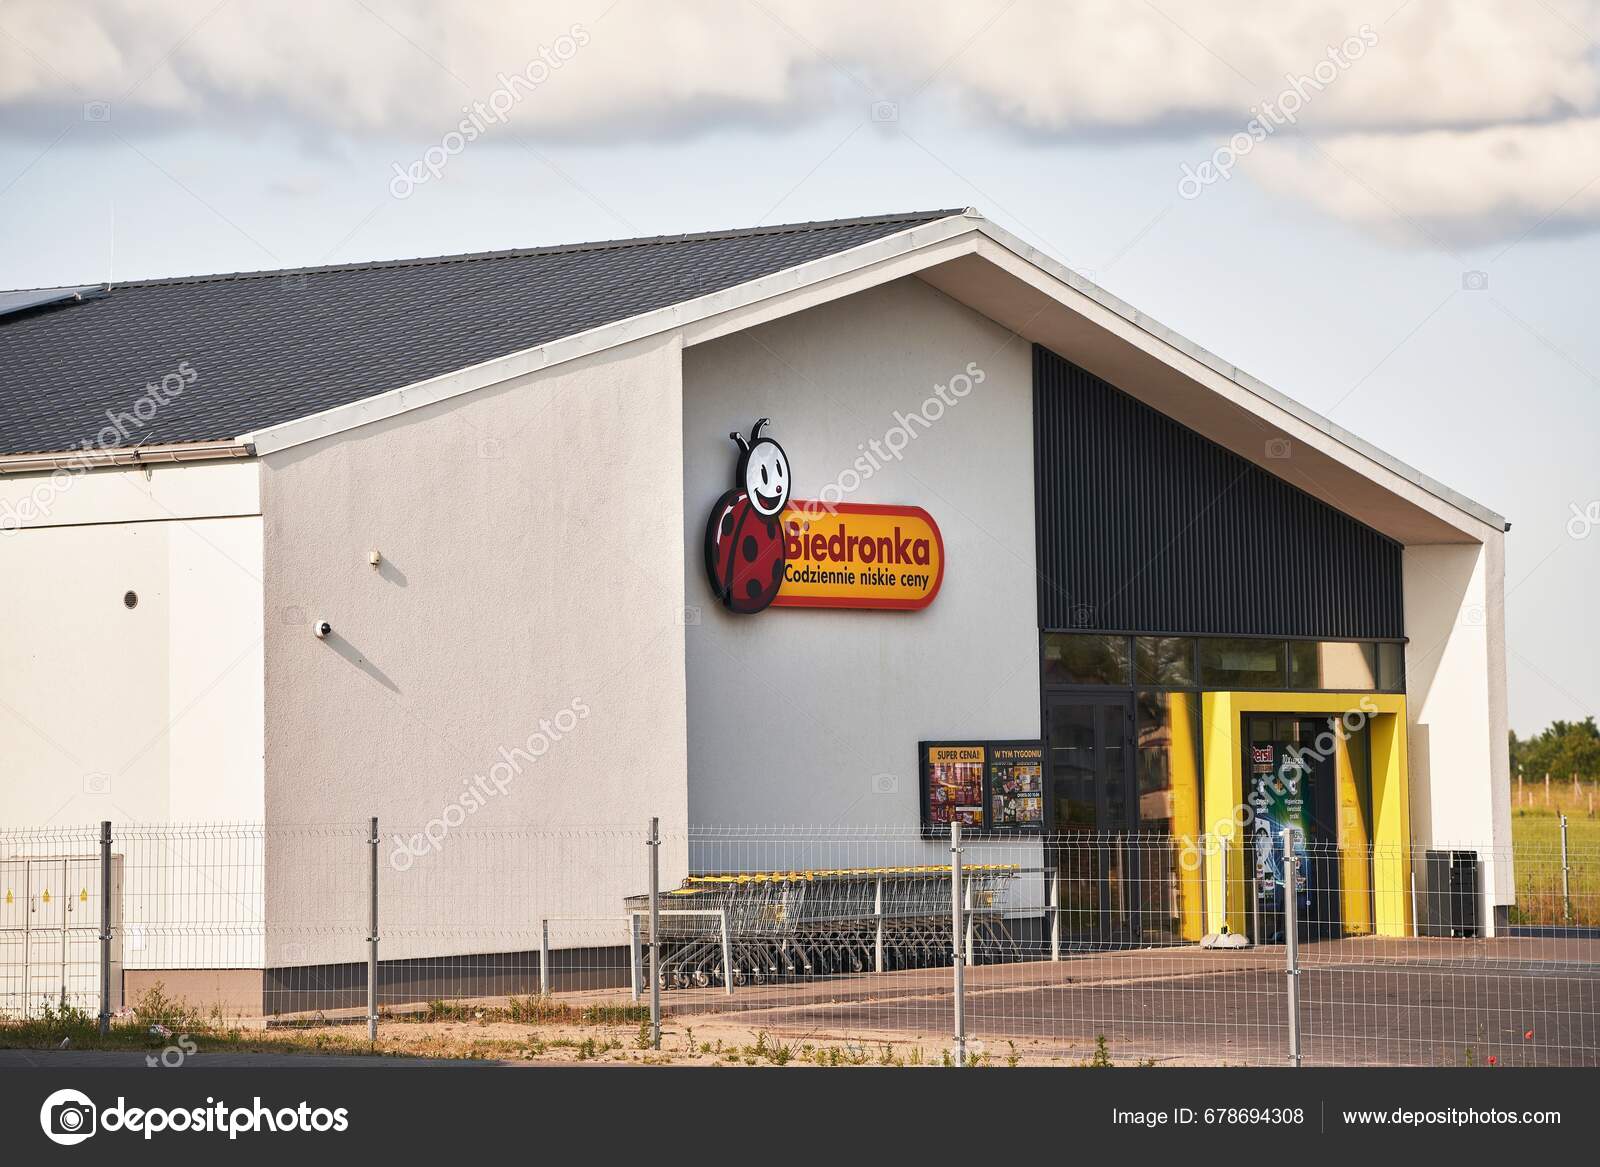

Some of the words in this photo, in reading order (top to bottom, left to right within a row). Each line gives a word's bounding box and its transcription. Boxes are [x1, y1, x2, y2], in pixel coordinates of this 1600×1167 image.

[785, 521, 930, 566] Biedronka
[784, 564, 856, 585] Codziennie
[860, 567, 897, 587] niskie
[900, 573, 930, 591] ceny
[937, 750, 958, 760] SUPER
[960, 750, 980, 760] CENA!
[994, 750, 1001, 759] W
[1002, 750, 1013, 759] TYM
[1014, 749, 1042, 759] TYGODNIU
